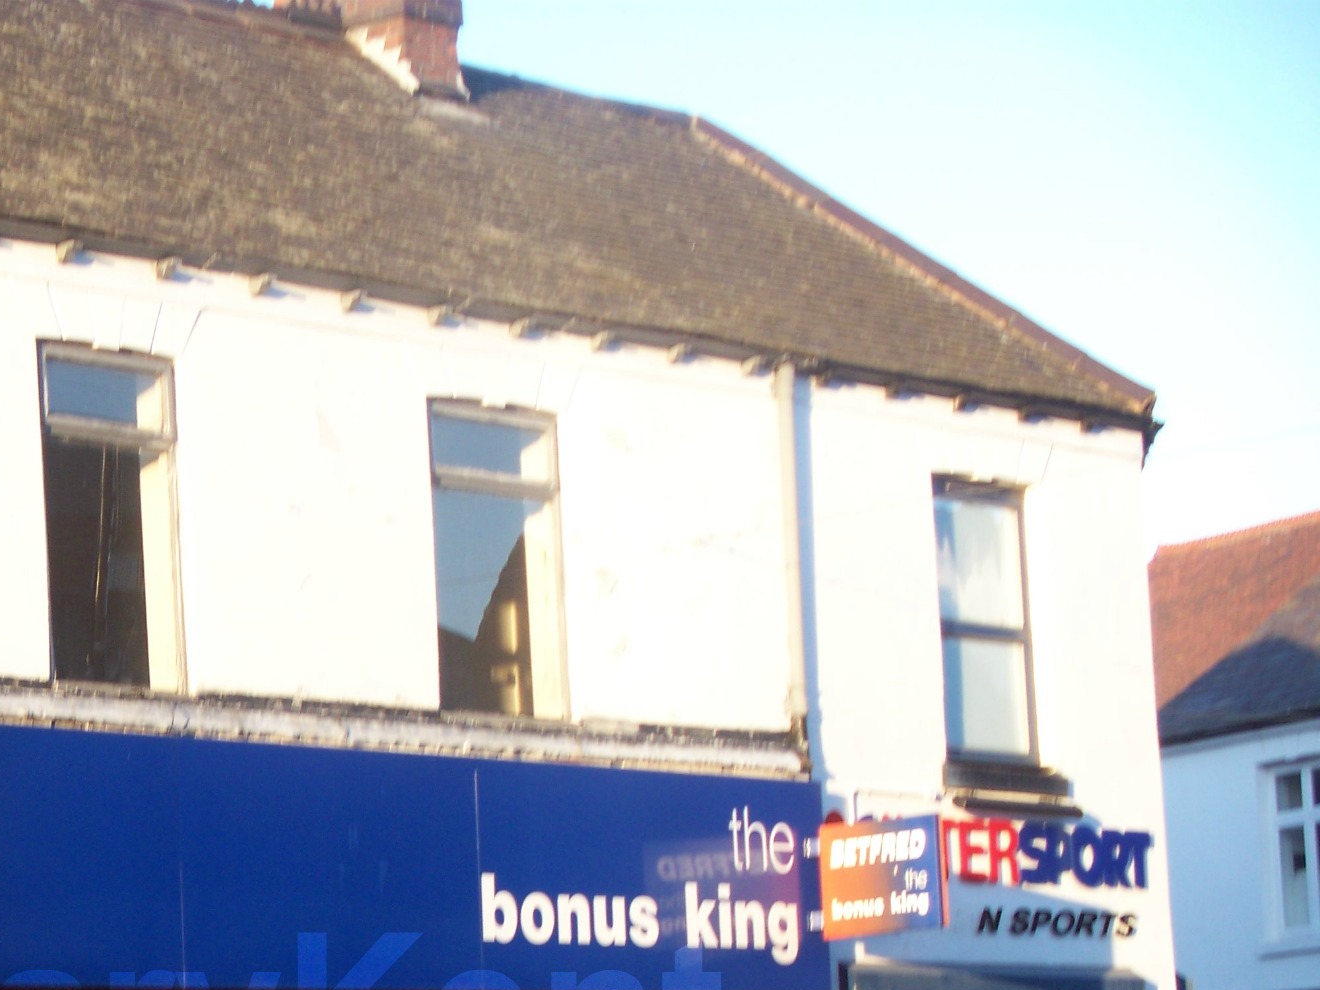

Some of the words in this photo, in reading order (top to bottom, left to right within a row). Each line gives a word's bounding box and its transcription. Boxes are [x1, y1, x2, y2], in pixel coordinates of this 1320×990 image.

[729, 805, 795, 874] the
[830, 828, 926, 870] BETFRED
[943, 815, 1154, 890] TERSPORT
[905, 867, 928, 890] the
[481, 872, 659, 948] bonus
[685, 881, 799, 965] king
[831, 897, 884, 922] bonus
[890, 890, 929, 917] king
[1008, 908, 1139, 939] SPORTS
